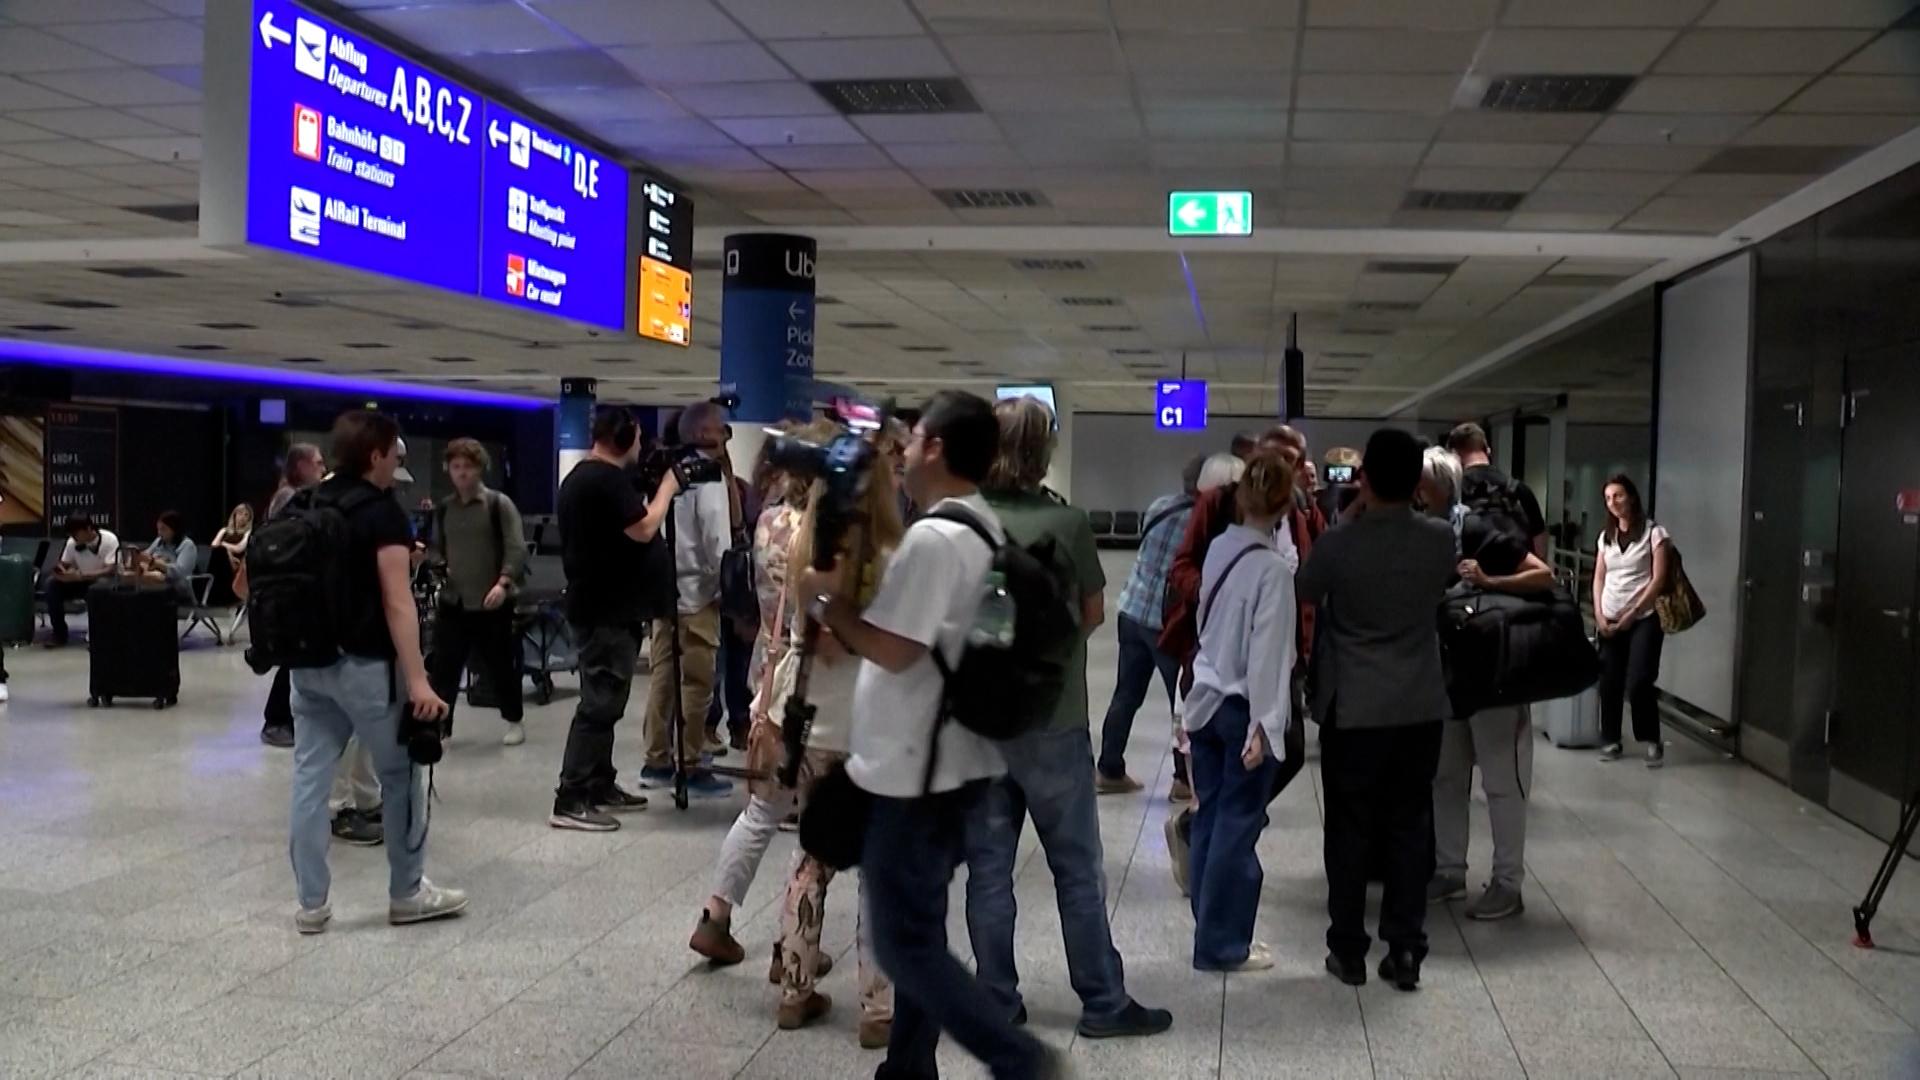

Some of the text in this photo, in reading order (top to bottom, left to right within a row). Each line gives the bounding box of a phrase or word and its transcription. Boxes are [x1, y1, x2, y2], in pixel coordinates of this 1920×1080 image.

[329, 34, 368, 75] Abflug
[327, 64, 388, 108] Departures
[327, 115, 378, 153] Bahnhöfe
[327, 145, 395, 188] Train stations
[574, 151, 599, 198] D,E
[362, 207, 406, 240] Terminal
[1161, 406, 1182, 426] C1
[51, 493, 95, 506] SERVICES
